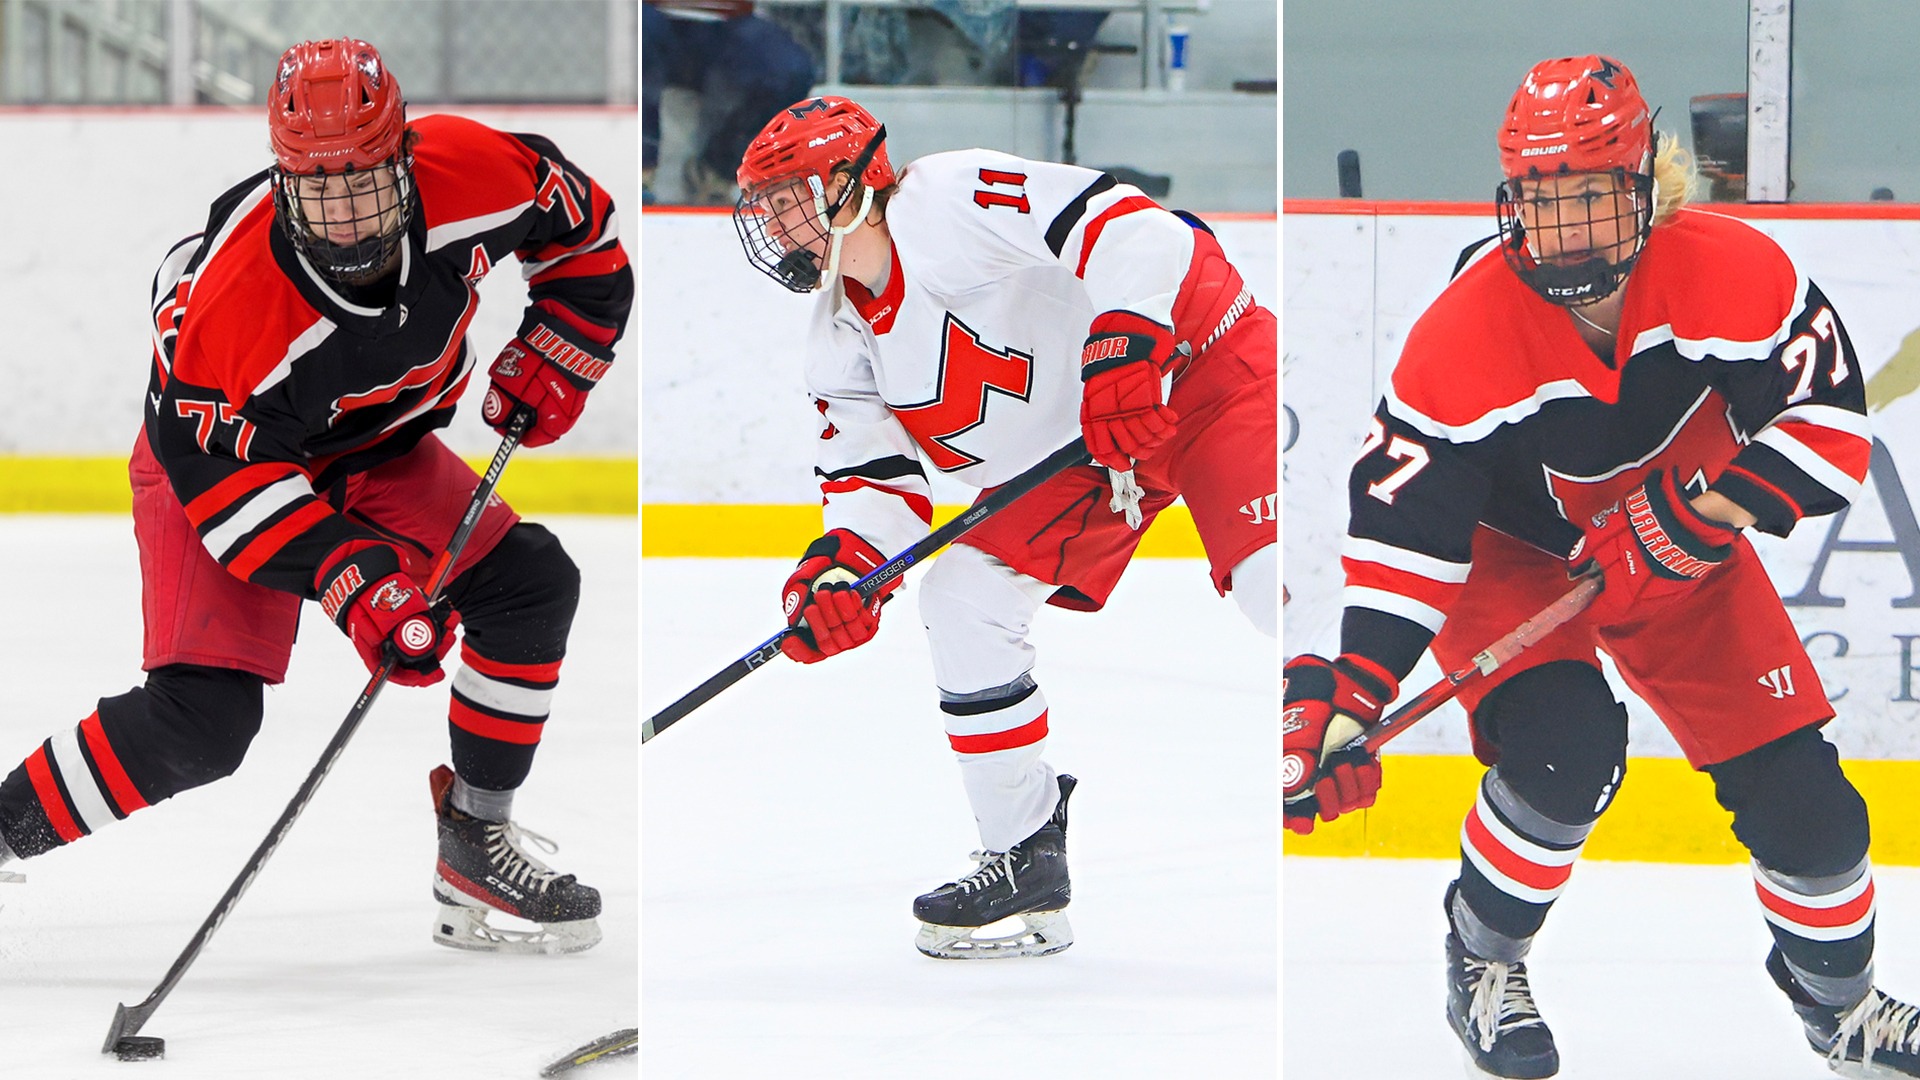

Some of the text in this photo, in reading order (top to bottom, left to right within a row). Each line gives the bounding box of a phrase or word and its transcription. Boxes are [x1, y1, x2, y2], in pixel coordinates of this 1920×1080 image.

[1521, 144, 1569, 157] BAUER
[973, 167, 1028, 214] 11
[1780, 306, 1849, 405] 77
[175, 399, 257, 462] 77
[861, 553, 914, 591] TRIGGER 9
[1624, 550, 1637, 576] ALPHA
[485, 874, 525, 901] CCM
